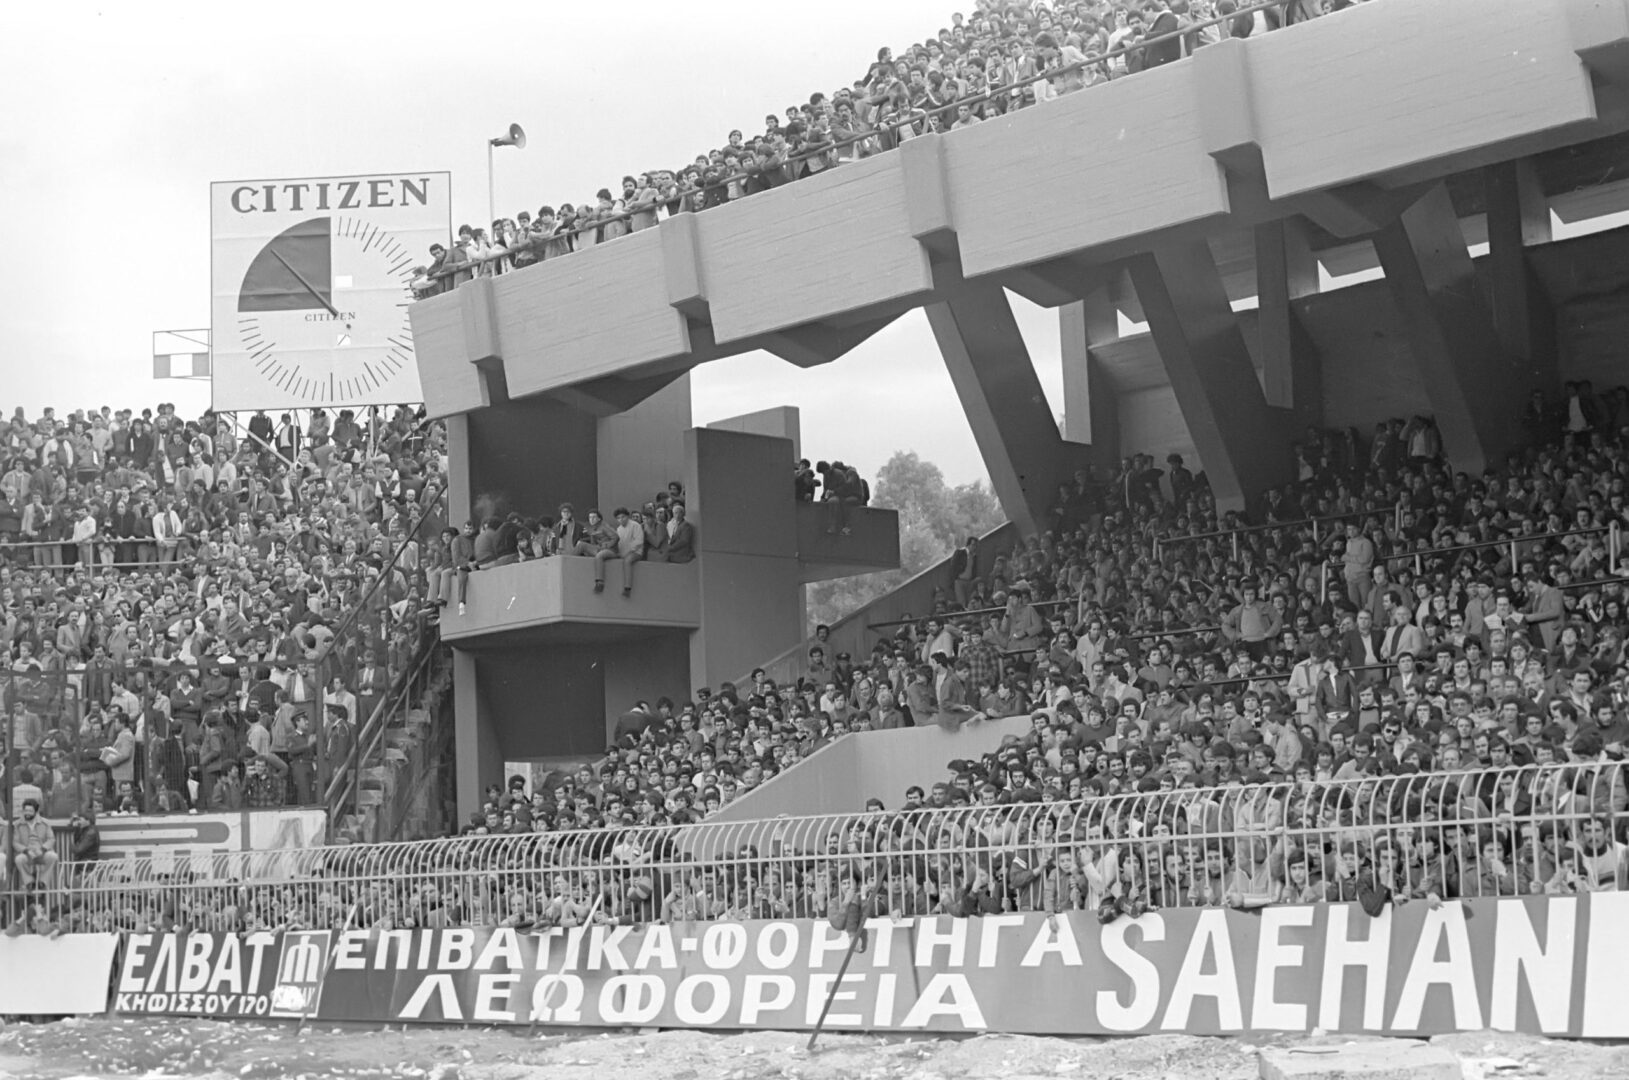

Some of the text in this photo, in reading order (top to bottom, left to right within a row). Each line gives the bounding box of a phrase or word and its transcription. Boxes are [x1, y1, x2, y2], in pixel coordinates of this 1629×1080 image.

[231, 178, 430, 213] CITIZEN
[119, 932, 275, 994] ΕΛΒΑΤ
[1096, 897, 1577, 1033] SAEHAN
[115, 993, 237, 1014] ΚΗΦΙΣΣΟΥ
[238, 995, 269, 1015] 170
[398, 973, 988, 1029] ΛΕΩΦΟΡΕΙΑ
